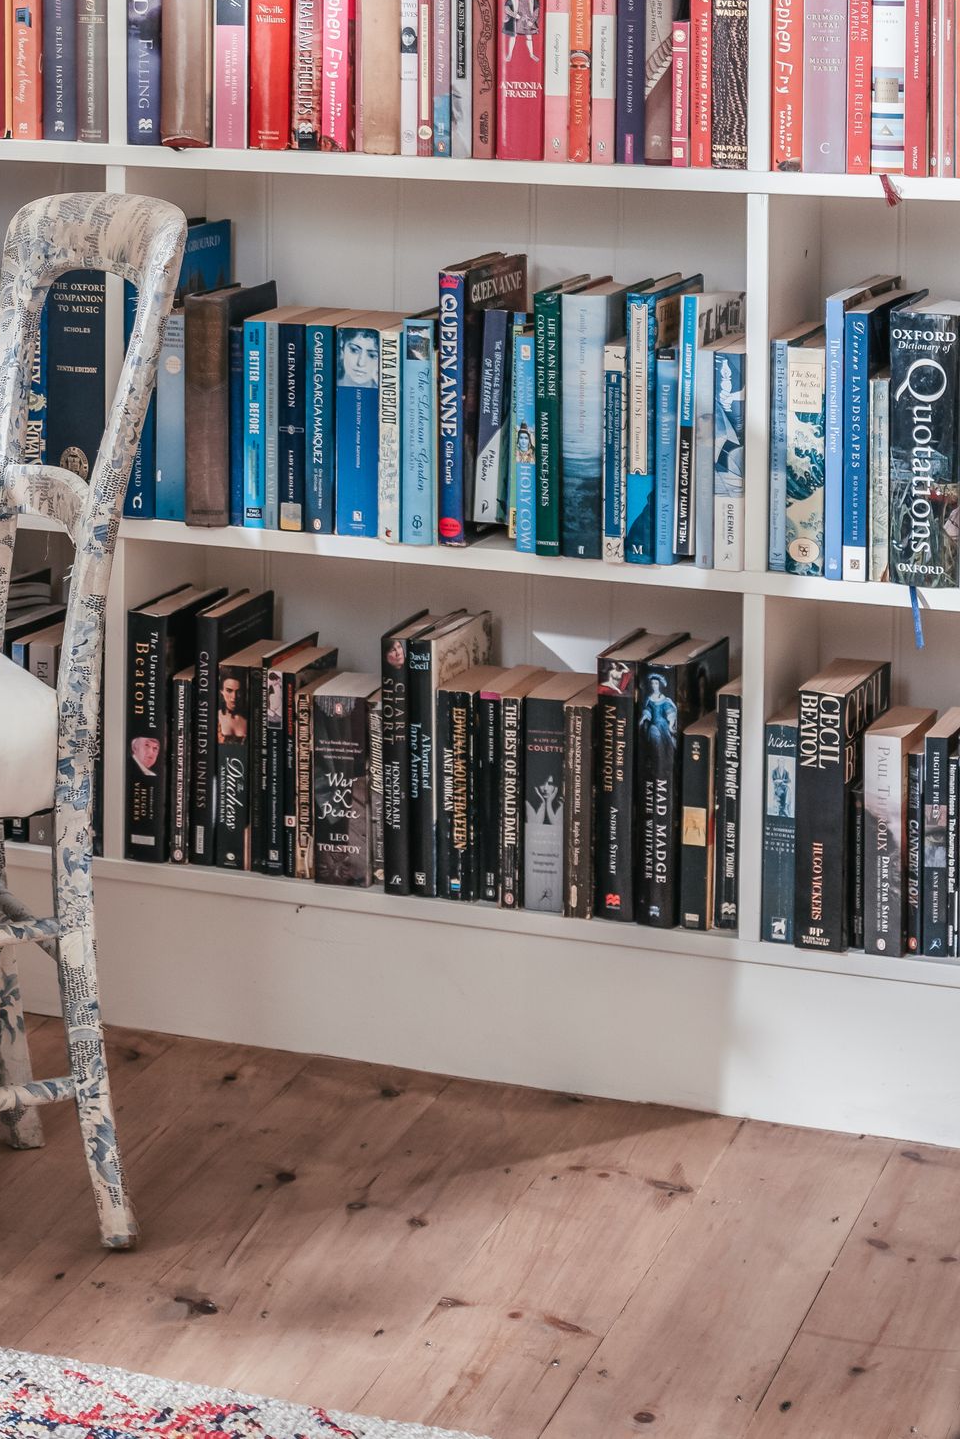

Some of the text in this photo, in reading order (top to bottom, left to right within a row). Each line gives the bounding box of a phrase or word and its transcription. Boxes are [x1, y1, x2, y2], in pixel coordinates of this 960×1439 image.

[139, 39, 153, 109] FALLING
[299, 57, 312, 114] PHILLIPS
[327, 47, 342, 79] Fry
[776, 61, 793, 94] Fry
[314, 332, 323, 373] GABRIEL
[441, 294, 457, 437] QUEEN ANNE
[892, 329, 956, 342] OXFORD
[898, 340, 953, 354] Dictionary of
[249, 350, 259, 434] BETTER BEFORE
[287, 343, 296, 407] GLENARVON
[381, 339, 397, 425] MAYA ANGELOU
[828, 338, 840, 453] The Conversation Piece
[540, 412, 549, 507] MARK BENCE-JONES
[851, 376, 860, 468] LANDSCAPES
[895, 358, 947, 553] Quotations
[898, 564, 944, 575] OXFORD
[135, 642, 149, 715] Beaton
[196, 652, 209, 808] CAROL SHIELDS UNLESS
[725, 709, 740, 800] Marching Powder
[799, 694, 818, 768] BEATON
[819, 696, 840, 769] CECIL
[504, 705, 516, 847] THE BEST OF ROALD DAHL
[656, 779, 667, 884] MAD MADGE
[811, 843, 823, 920] HUGO VICKERS
